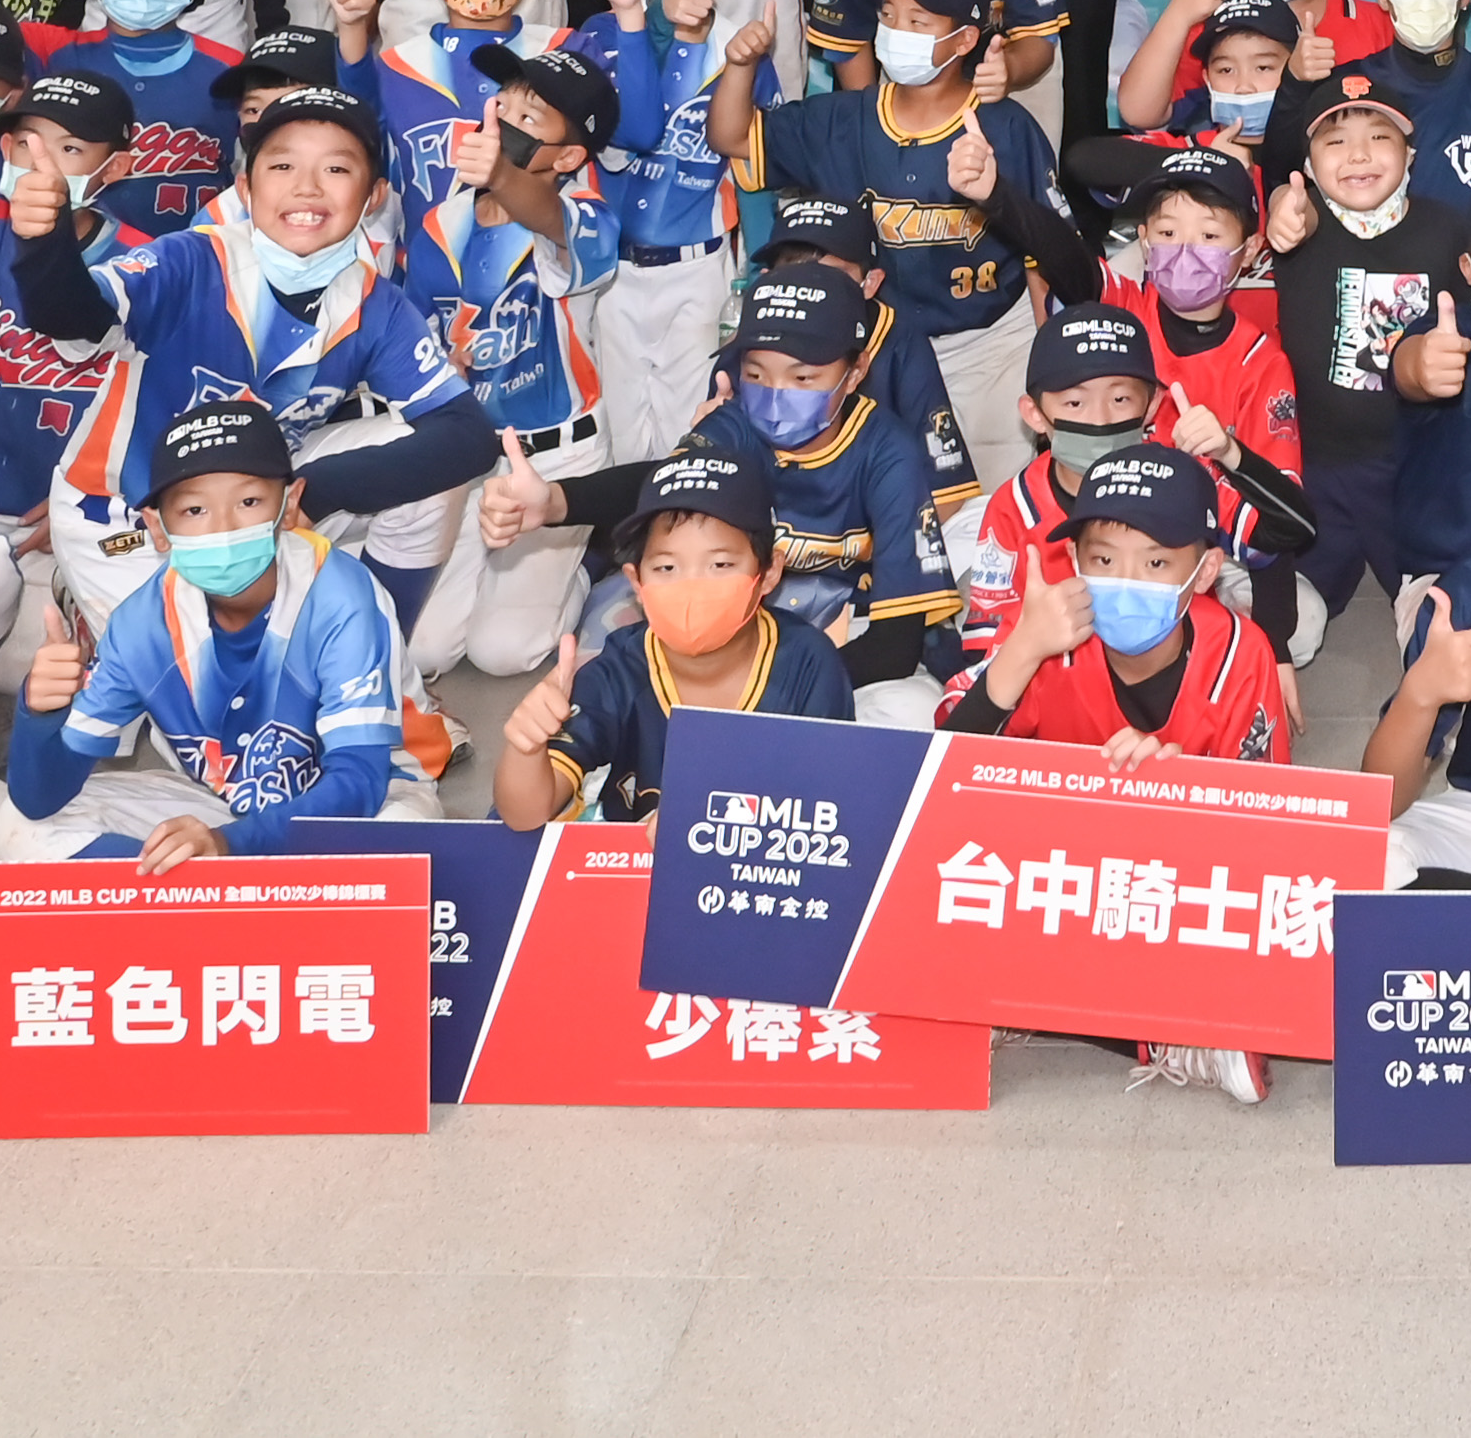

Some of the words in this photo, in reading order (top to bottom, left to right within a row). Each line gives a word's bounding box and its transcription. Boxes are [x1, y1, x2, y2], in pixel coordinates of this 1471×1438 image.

[950, 260, 998, 300] 38
[0, 889, 47, 907] 2022
[49, 888, 93, 906] MLB
[96, 888, 138, 905] CUP
[141, 886, 221, 904] TAIWAN
[934, 840, 1338, 959] 台中騎士隊
[10, 963, 376, 1048] 藍色閃電
